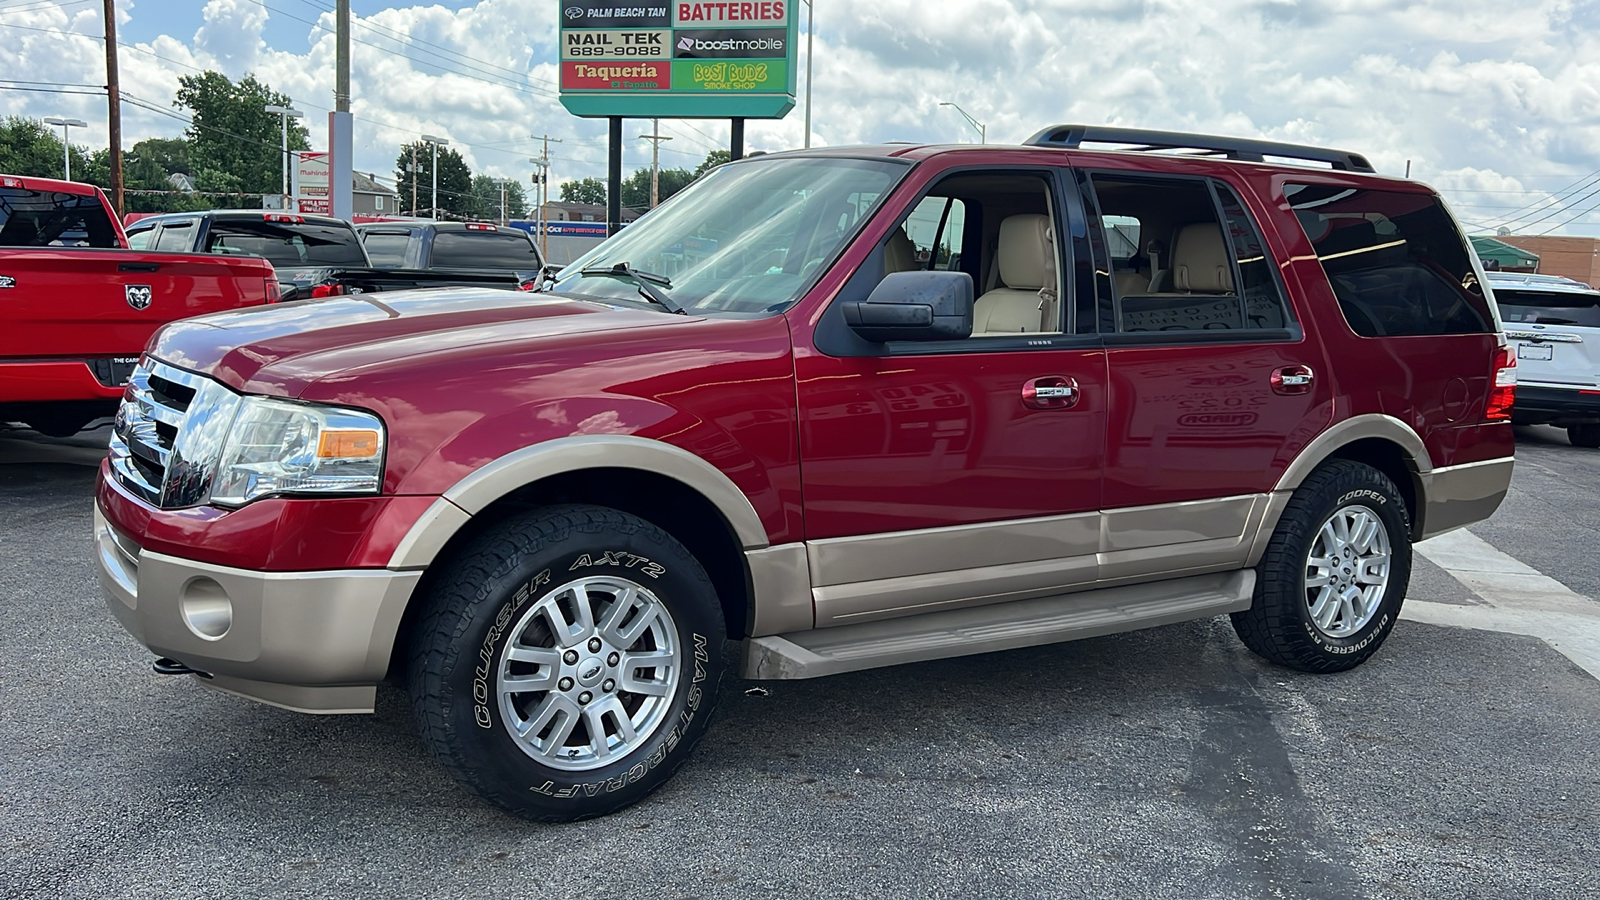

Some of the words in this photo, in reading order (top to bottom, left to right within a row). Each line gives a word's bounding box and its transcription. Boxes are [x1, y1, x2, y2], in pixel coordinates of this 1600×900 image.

[587, 8, 613, 18] PALM
[614, 7, 646, 18] BEACH
[648, 7, 666, 17] TAN
[678, 1, 784, 22] BATTERIES
[567, 33, 613, 46] NAIL
[621, 32, 663, 45] TEK
[570, 46, 661, 57] 689-9088
[574, 62, 658, 81] Taquería
[729, 62, 768, 82] BUDZ
[703, 82, 731, 90] SMOKE
[732, 82, 756, 90] SHOP
[1336, 489, 1388, 506] COOPER
[473, 567, 552, 729] COURSER
[568, 550, 667, 579] AXT2
[1324, 613, 1389, 654] DISCOVERER
[529, 632, 710, 799] MASTERCRAFT
